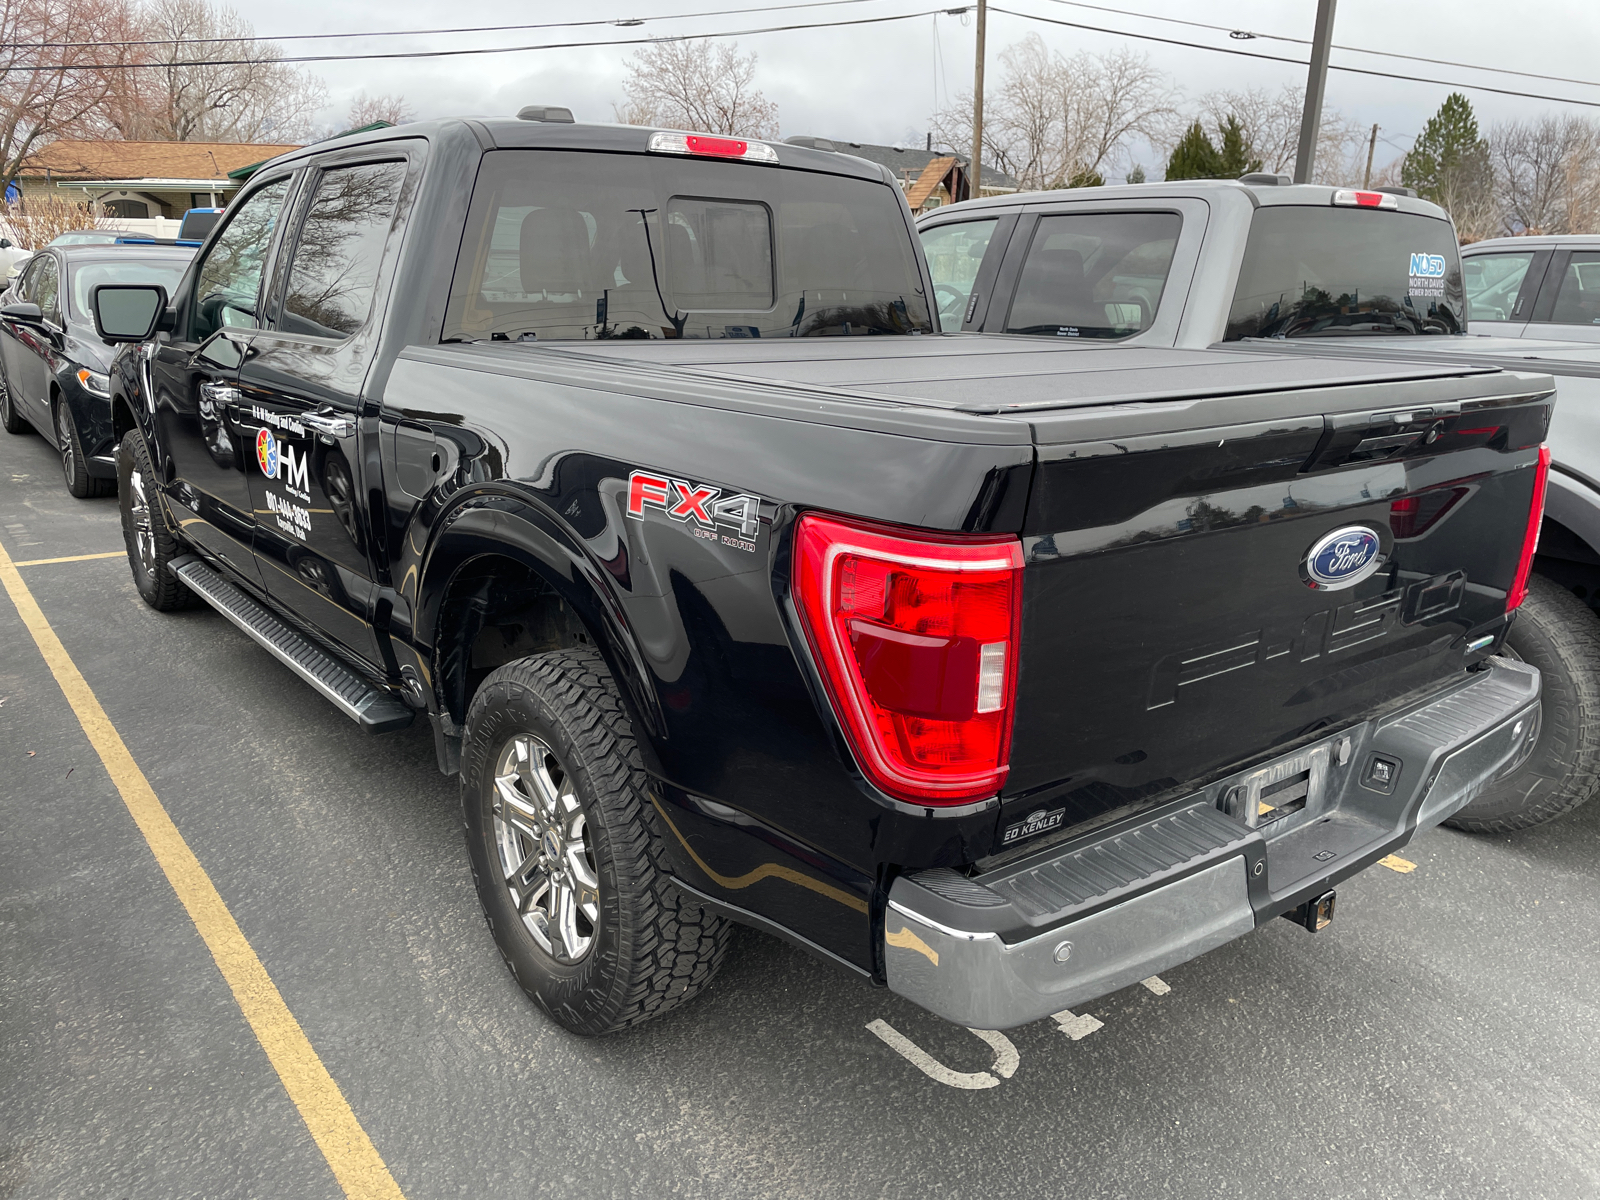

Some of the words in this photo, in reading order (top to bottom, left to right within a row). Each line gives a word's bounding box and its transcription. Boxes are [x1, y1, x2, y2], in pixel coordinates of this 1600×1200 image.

[1408, 278, 1429, 288] NORTH
[1429, 279, 1445, 289] DAVIS
[1408, 288, 1424, 297] SEWER
[1424, 289, 1444, 298] DISTRICT
[626, 469, 761, 542] FX4
[694, 528, 718, 541] OFF
[721, 535, 756, 552] ROAD
[1328, 537, 1369, 574] Ford
[1146, 567, 1468, 711] F-150
[1003, 828, 1019, 841] ED
[1021, 812, 1064, 836] KENLEY
